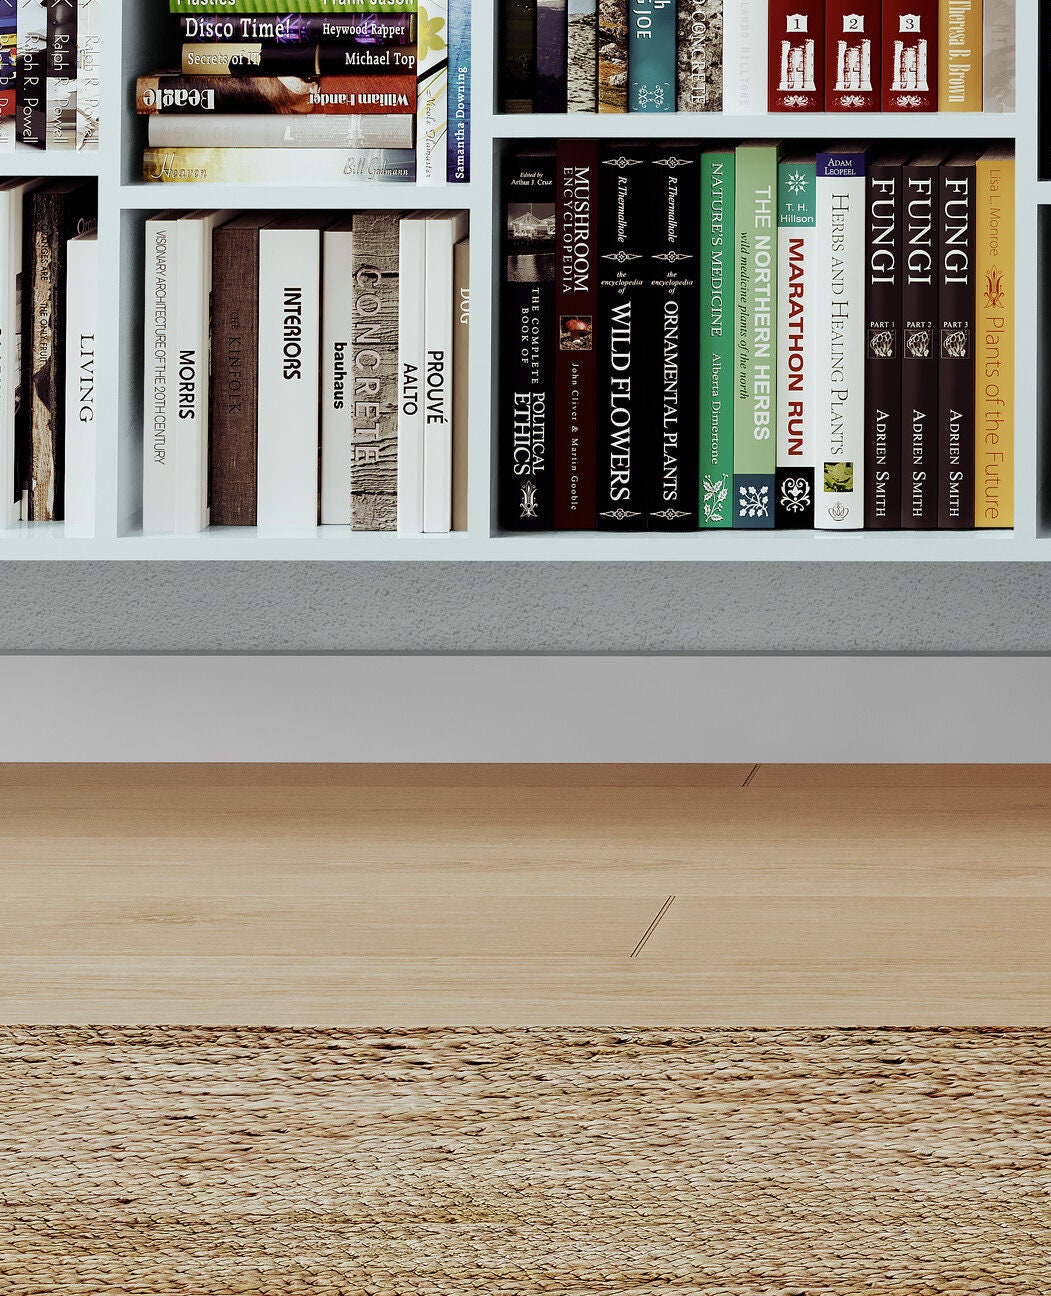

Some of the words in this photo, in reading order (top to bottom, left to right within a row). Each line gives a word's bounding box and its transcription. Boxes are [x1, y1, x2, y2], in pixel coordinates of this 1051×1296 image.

[184, 16, 234, 39] Disco
[239, 16, 289, 39] Time!
[322, 23, 368, 37] Heywood
[370, 23, 405, 38] Rapper
[637, 12, 652, 40] JOE
[187, 51, 230, 65] Secrets
[231, 51, 245, 65] of
[344, 51, 390, 65] Michael
[393, 51, 415, 68] Top
[690, 11, 707, 105] CONCRETE
[948, 48, 972, 61] B.
[142, 88, 215, 110] Beagle
[307, 90, 353, 106] Hander
[354, 91, 409, 106] William
[455, 66, 468, 115] Downing
[948, 64, 972, 103] Brown
[455, 116, 466, 179] Samantha
[824, 167, 856, 176] LEOPEEL
[827, 158, 852, 167] ADAM
[563, 167, 573, 293] ENCYCLOPEDIA
[574, 166, 589, 292] MUSHROOM
[711, 163, 723, 246] NATURE'S
[755, 185, 771, 228] THE
[780, 214, 814, 223] Hillson
[832, 194, 849, 251] HERBS
[871, 177, 895, 285] FUNGI
[156, 231, 166, 277] VISIONARY
[738, 232, 749, 255] wild
[711, 251, 723, 337] MEDICINE
[738, 256, 749, 303] medicine
[754, 235, 771, 358] NORTHERN
[831, 257, 844, 295] AND
[155, 278, 166, 348] ARCHITECTURE
[283, 286, 302, 380] INTERIORS
[611, 301, 631, 371] WILD
[738, 305, 749, 337] plants
[788, 239, 804, 391] MARATHON
[155, 350, 166, 363] OF
[353, 265, 382, 462] CONCRETE
[522, 349, 529, 364] OF
[531, 318, 539, 384] COMPLETE
[663, 301, 679, 429] ORNAMENTAL
[738, 339, 749, 352] of
[740, 353, 750, 368] the
[831, 301, 848, 382] HEALING
[985, 317, 1004, 378] Plants
[79, 332, 95, 424] LIVING
[154, 364, 165, 384] THE
[154, 386, 165, 413] 20TH
[178, 349, 196, 420] MORRIS
[334, 341, 347, 410] bauhaus
[403, 363, 418, 417] AALTO
[427, 349, 449, 425] PROUVÉ
[711, 353, 722, 397] Alberta
[740, 371, 750, 400] north
[985, 384, 1005, 406] of
[753, 365, 770, 440] HERBS
[787, 401, 803, 456] RUN
[830, 389, 848, 455] PLANTS
[985, 411, 1004, 445] the
[154, 415, 165, 465] CENTURY
[513, 392, 531, 475] ETHICS
[532, 392, 545, 475] POLITICAL
[610, 377, 631, 501] FLOWERS
[711, 401, 721, 465] Dimertone
[876, 409, 890, 465] ADRIEN
[663, 432, 678, 501] PLANTS
[876, 471, 890, 517] SMITH
[985, 452, 1004, 519] Future
